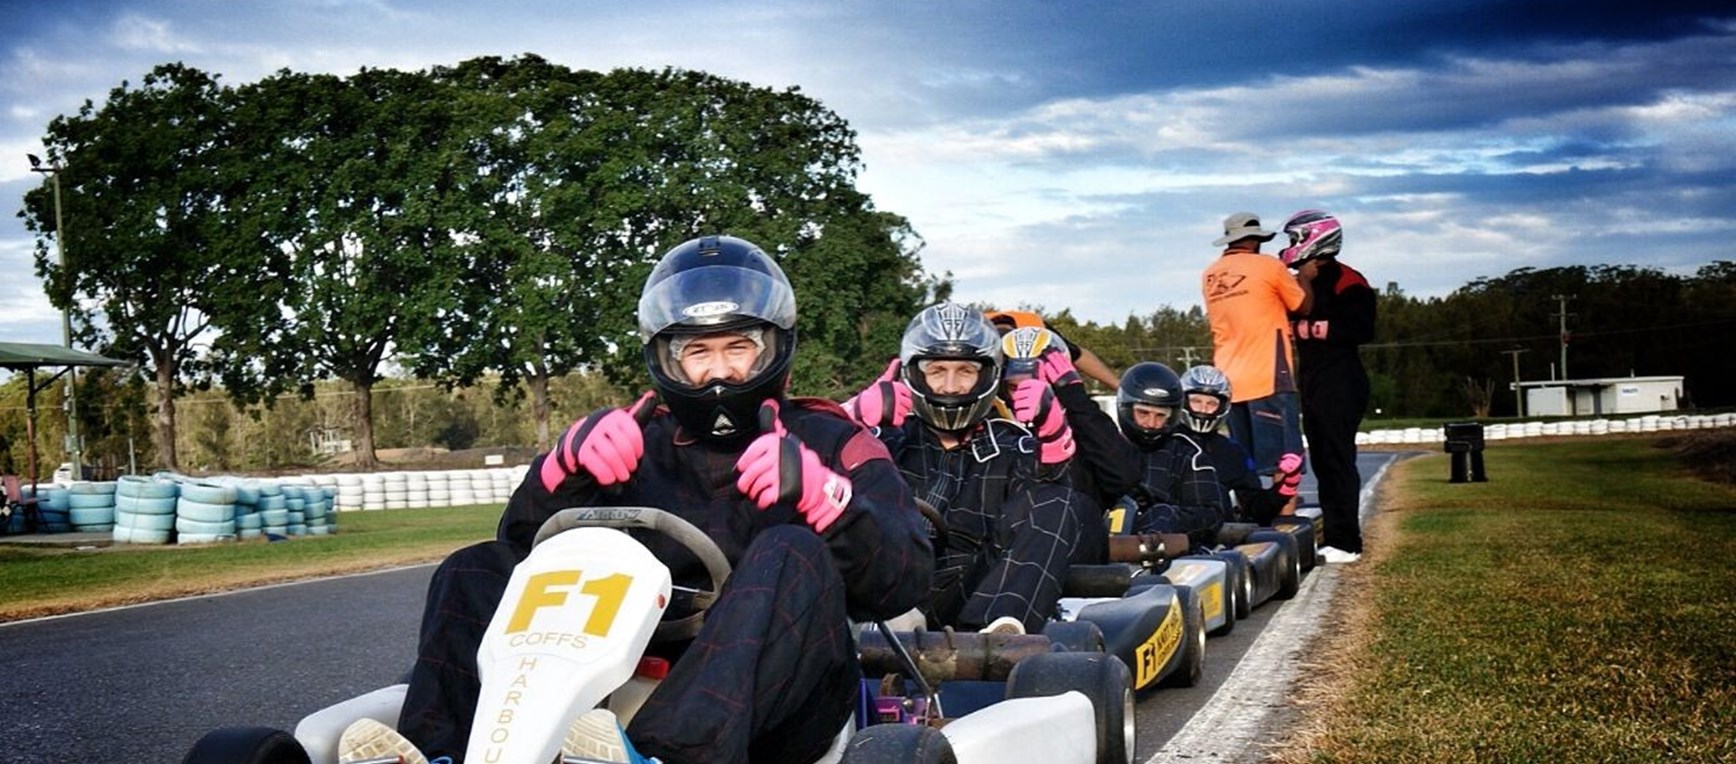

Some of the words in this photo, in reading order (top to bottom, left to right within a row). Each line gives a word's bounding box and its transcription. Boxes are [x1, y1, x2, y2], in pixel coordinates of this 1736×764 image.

[504, 569, 634, 638] F1
[509, 632, 588, 649] COFFS
[1143, 642, 1156, 679] F1
